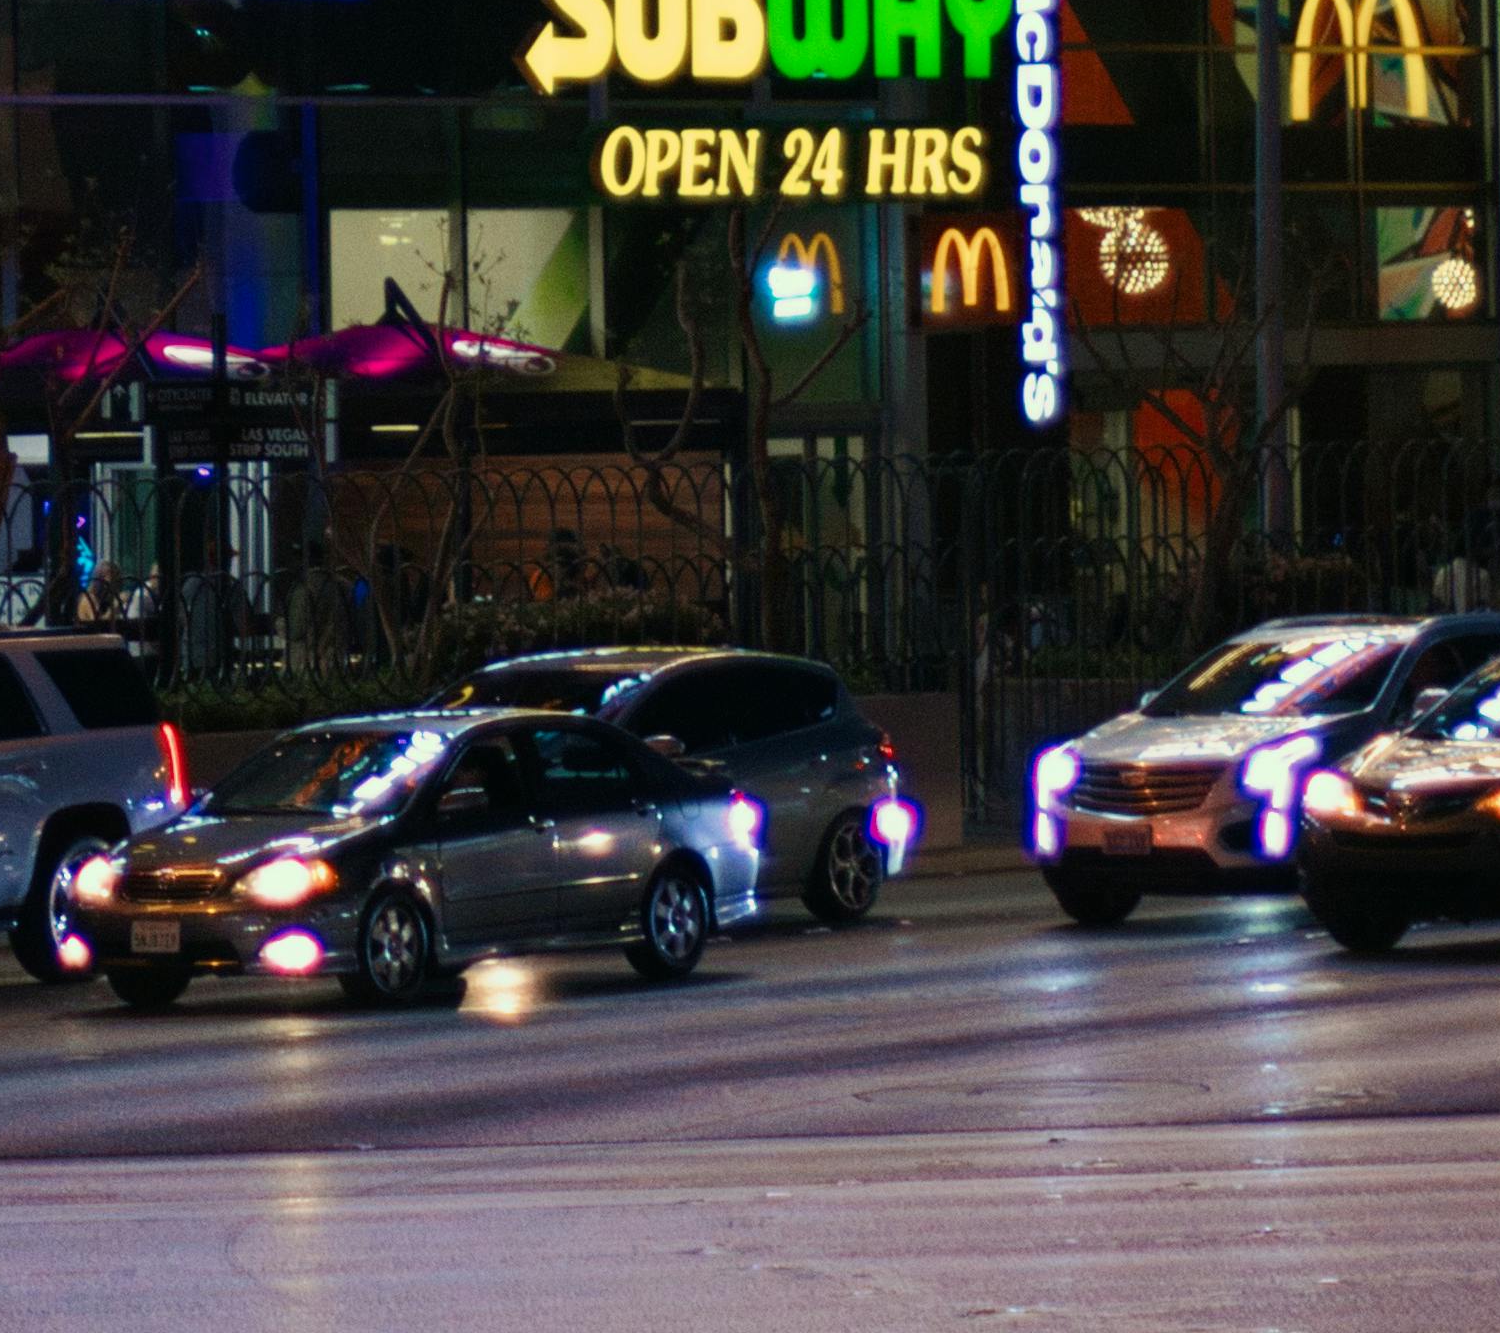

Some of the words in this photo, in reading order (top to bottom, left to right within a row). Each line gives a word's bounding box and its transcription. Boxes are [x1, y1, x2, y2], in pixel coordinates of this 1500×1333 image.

[599, 125, 761, 197] OPEN
[779, 127, 844, 197] 24
[863, 126, 984, 196] HRS
[241, 427, 264, 442] LAS
[266, 427, 309, 442] VEGAS
[229, 443, 262, 458] STRIP
[264, 443, 309, 458] SOUTH
